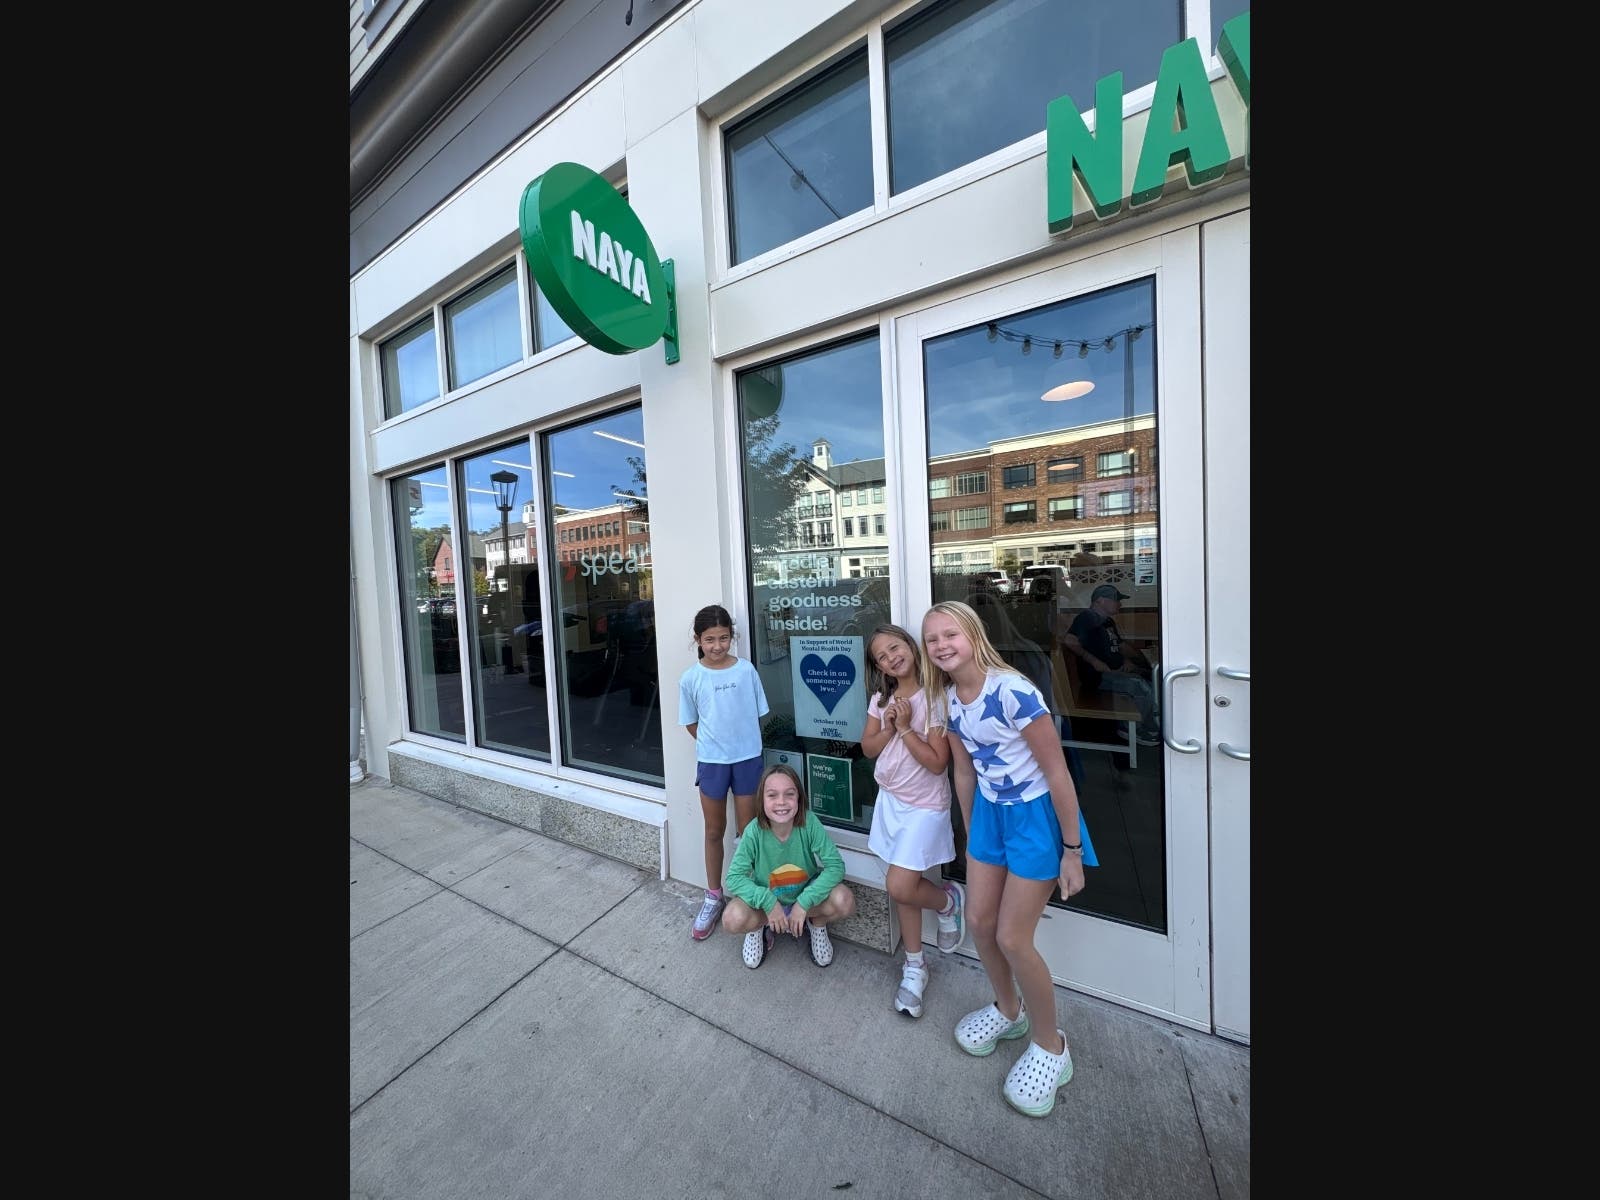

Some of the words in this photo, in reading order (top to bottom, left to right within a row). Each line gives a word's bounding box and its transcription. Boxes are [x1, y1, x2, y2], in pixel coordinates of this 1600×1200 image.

[571, 210, 651, 304] NAYA
[768, 553, 829, 569] ddle
[768, 573, 837, 589] eastern
[768, 593, 862, 612] goodness
[769, 616, 828, 631] inside!
